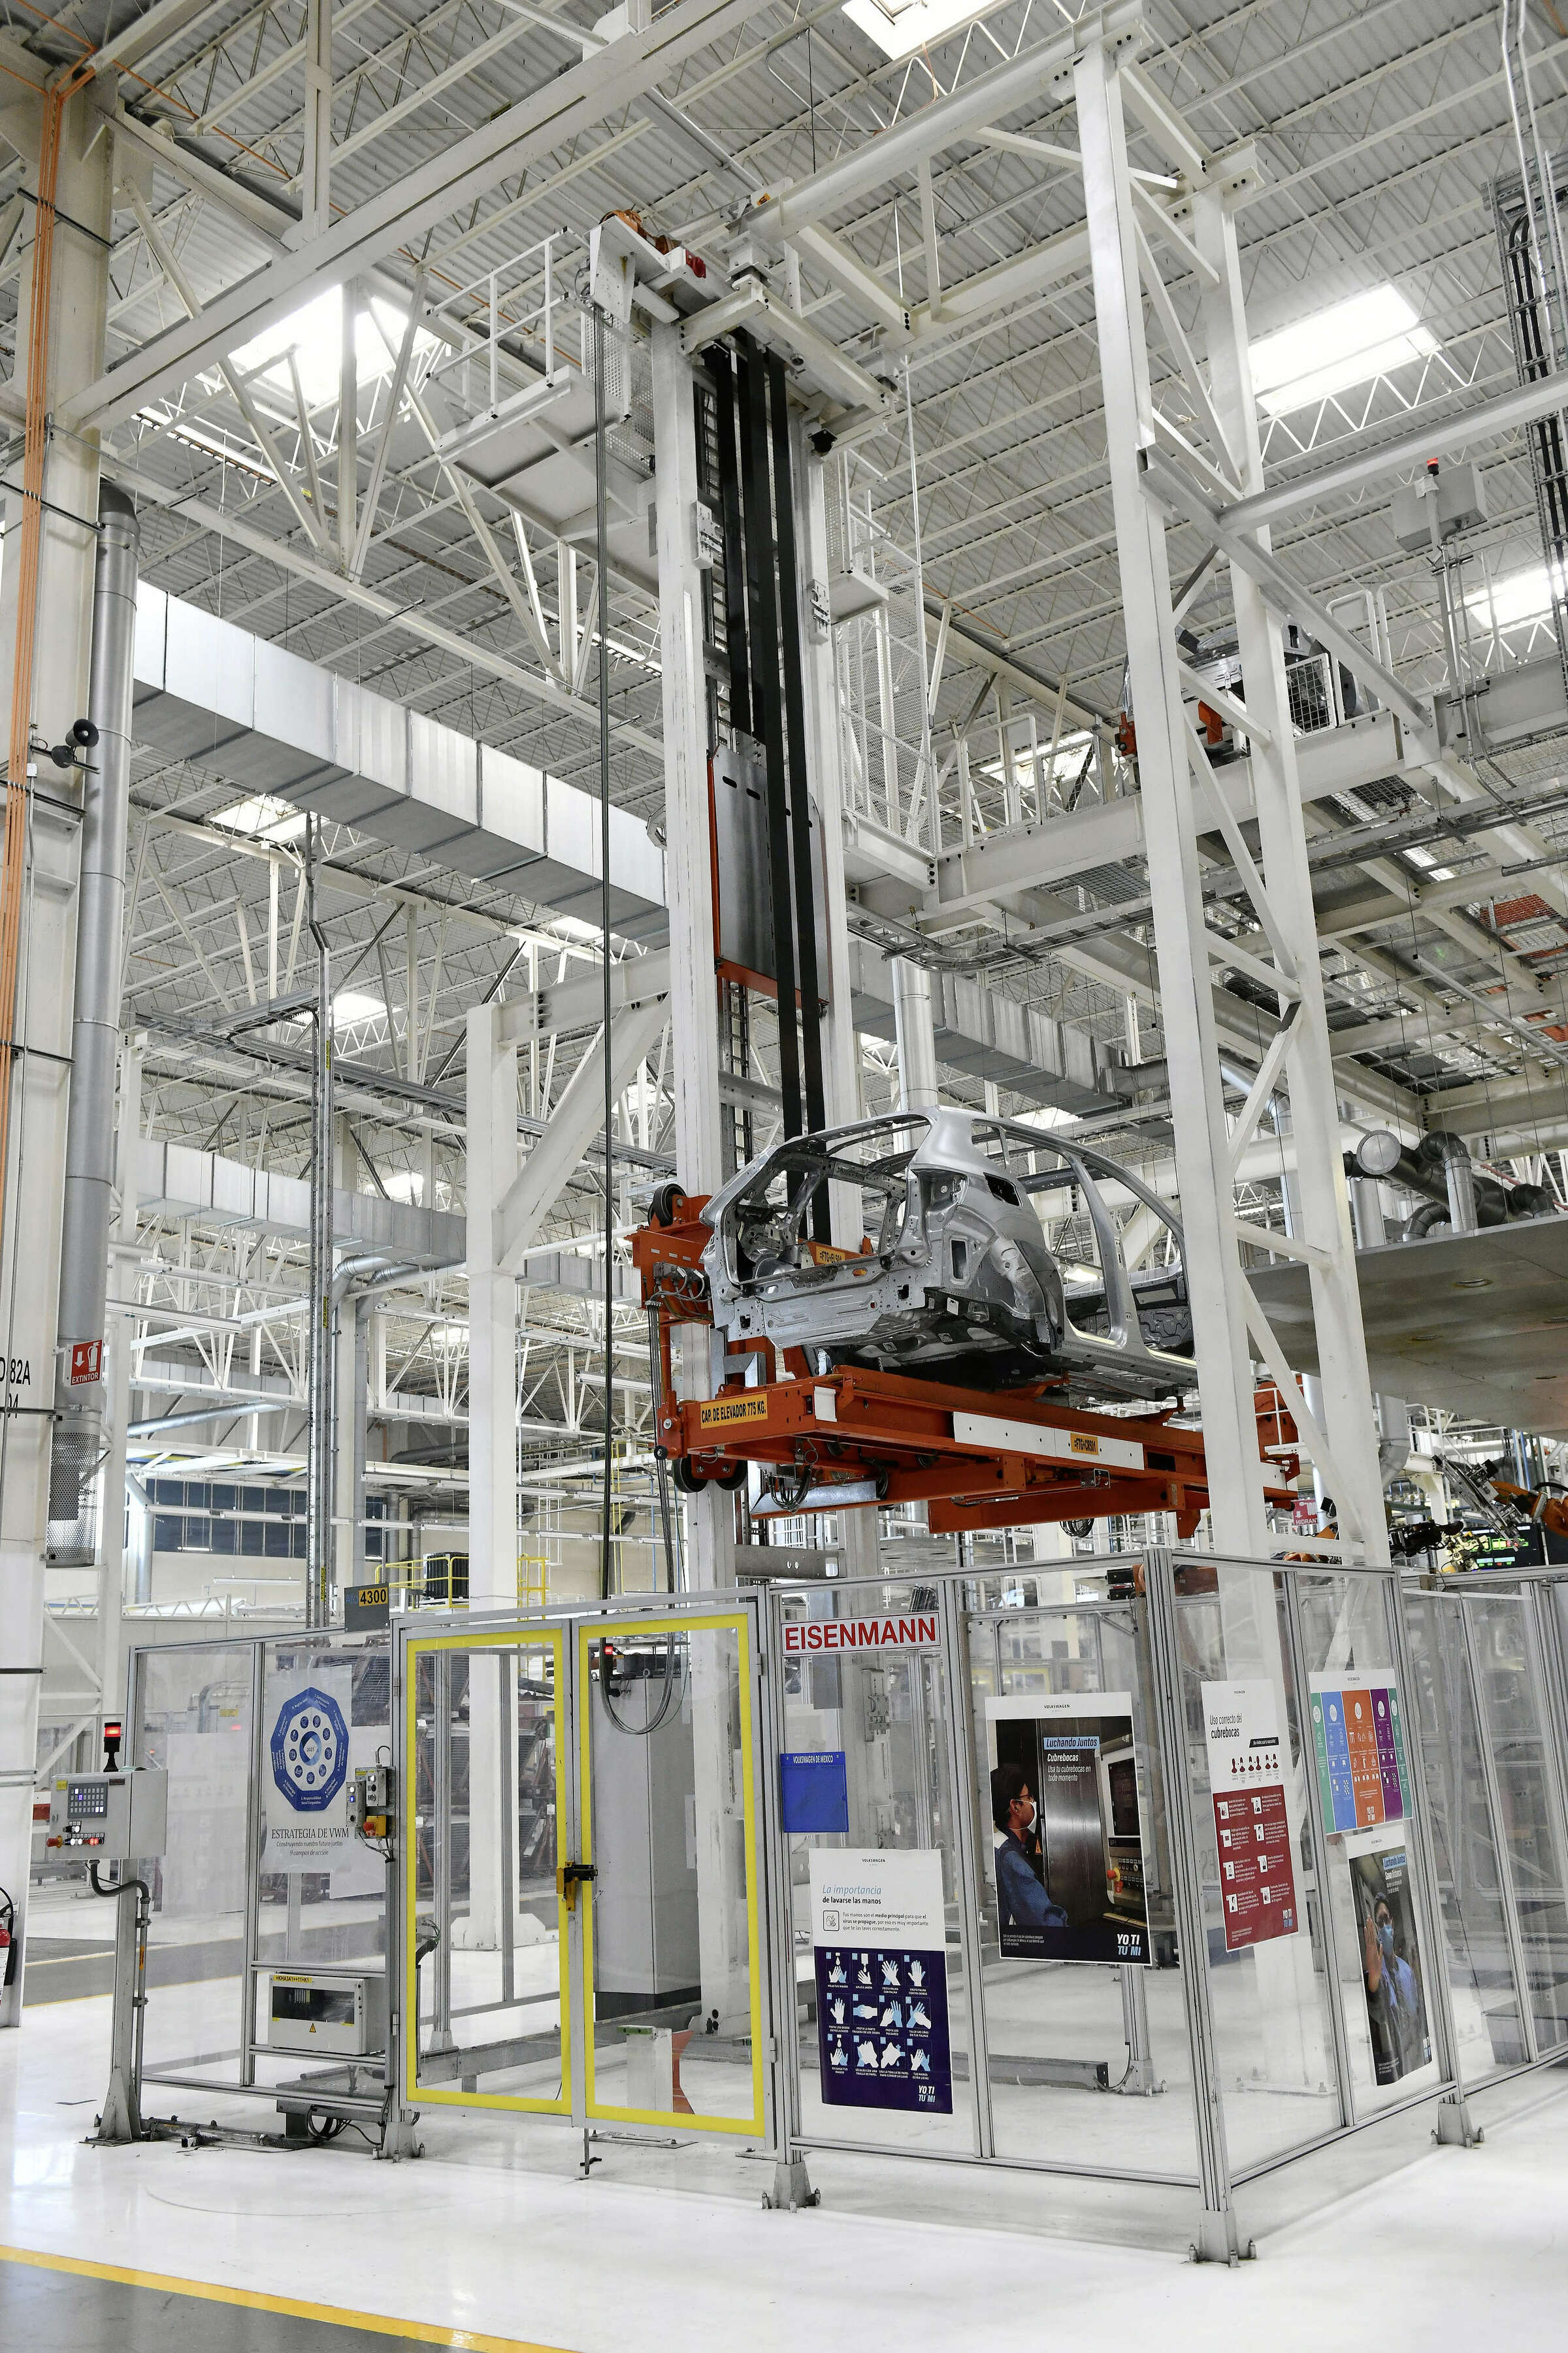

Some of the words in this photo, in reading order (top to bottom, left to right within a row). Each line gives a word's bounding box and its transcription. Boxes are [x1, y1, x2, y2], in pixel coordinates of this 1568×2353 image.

[10, 1358, 30, 1385] 82A
[72, 1373, 98, 1384] EXTINTOR
[702, 1410, 712, 1423] CAP.
[713, 1407, 719, 1421] DE
[721, 1404, 746, 1420] ELEVADOR
[747, 1402, 756, 1416] 775
[758, 1400, 766, 1415] KG.
[360, 1589, 386, 1604] 4300
[785, 1618, 936, 1651] EISENMANN
[1218, 1714, 1235, 1724] correcto
[1211, 1726, 1239, 1739] cubrebocas
[1047, 1737, 1075, 1747] Luchando
[1078, 1737, 1097, 1747] Juntos
[1047, 1753, 1079, 1762] Cubrebocas
[272, 1828, 316, 1839] ESTRATEGIA
[318, 1828, 327, 1838] DE
[330, 1828, 349, 1838] VWM
[823, 1885, 831, 1894] La
[834, 1884, 881, 1896] importancia
[1117, 1934, 1130, 1944] YO
[1131, 1934, 1139, 1945] TI
[1118, 1946, 1127, 1955] TU
[1130, 1947, 1141, 1956] MI
[919, 2085, 927, 2094] YO
[928, 2086, 934, 2094] TI
